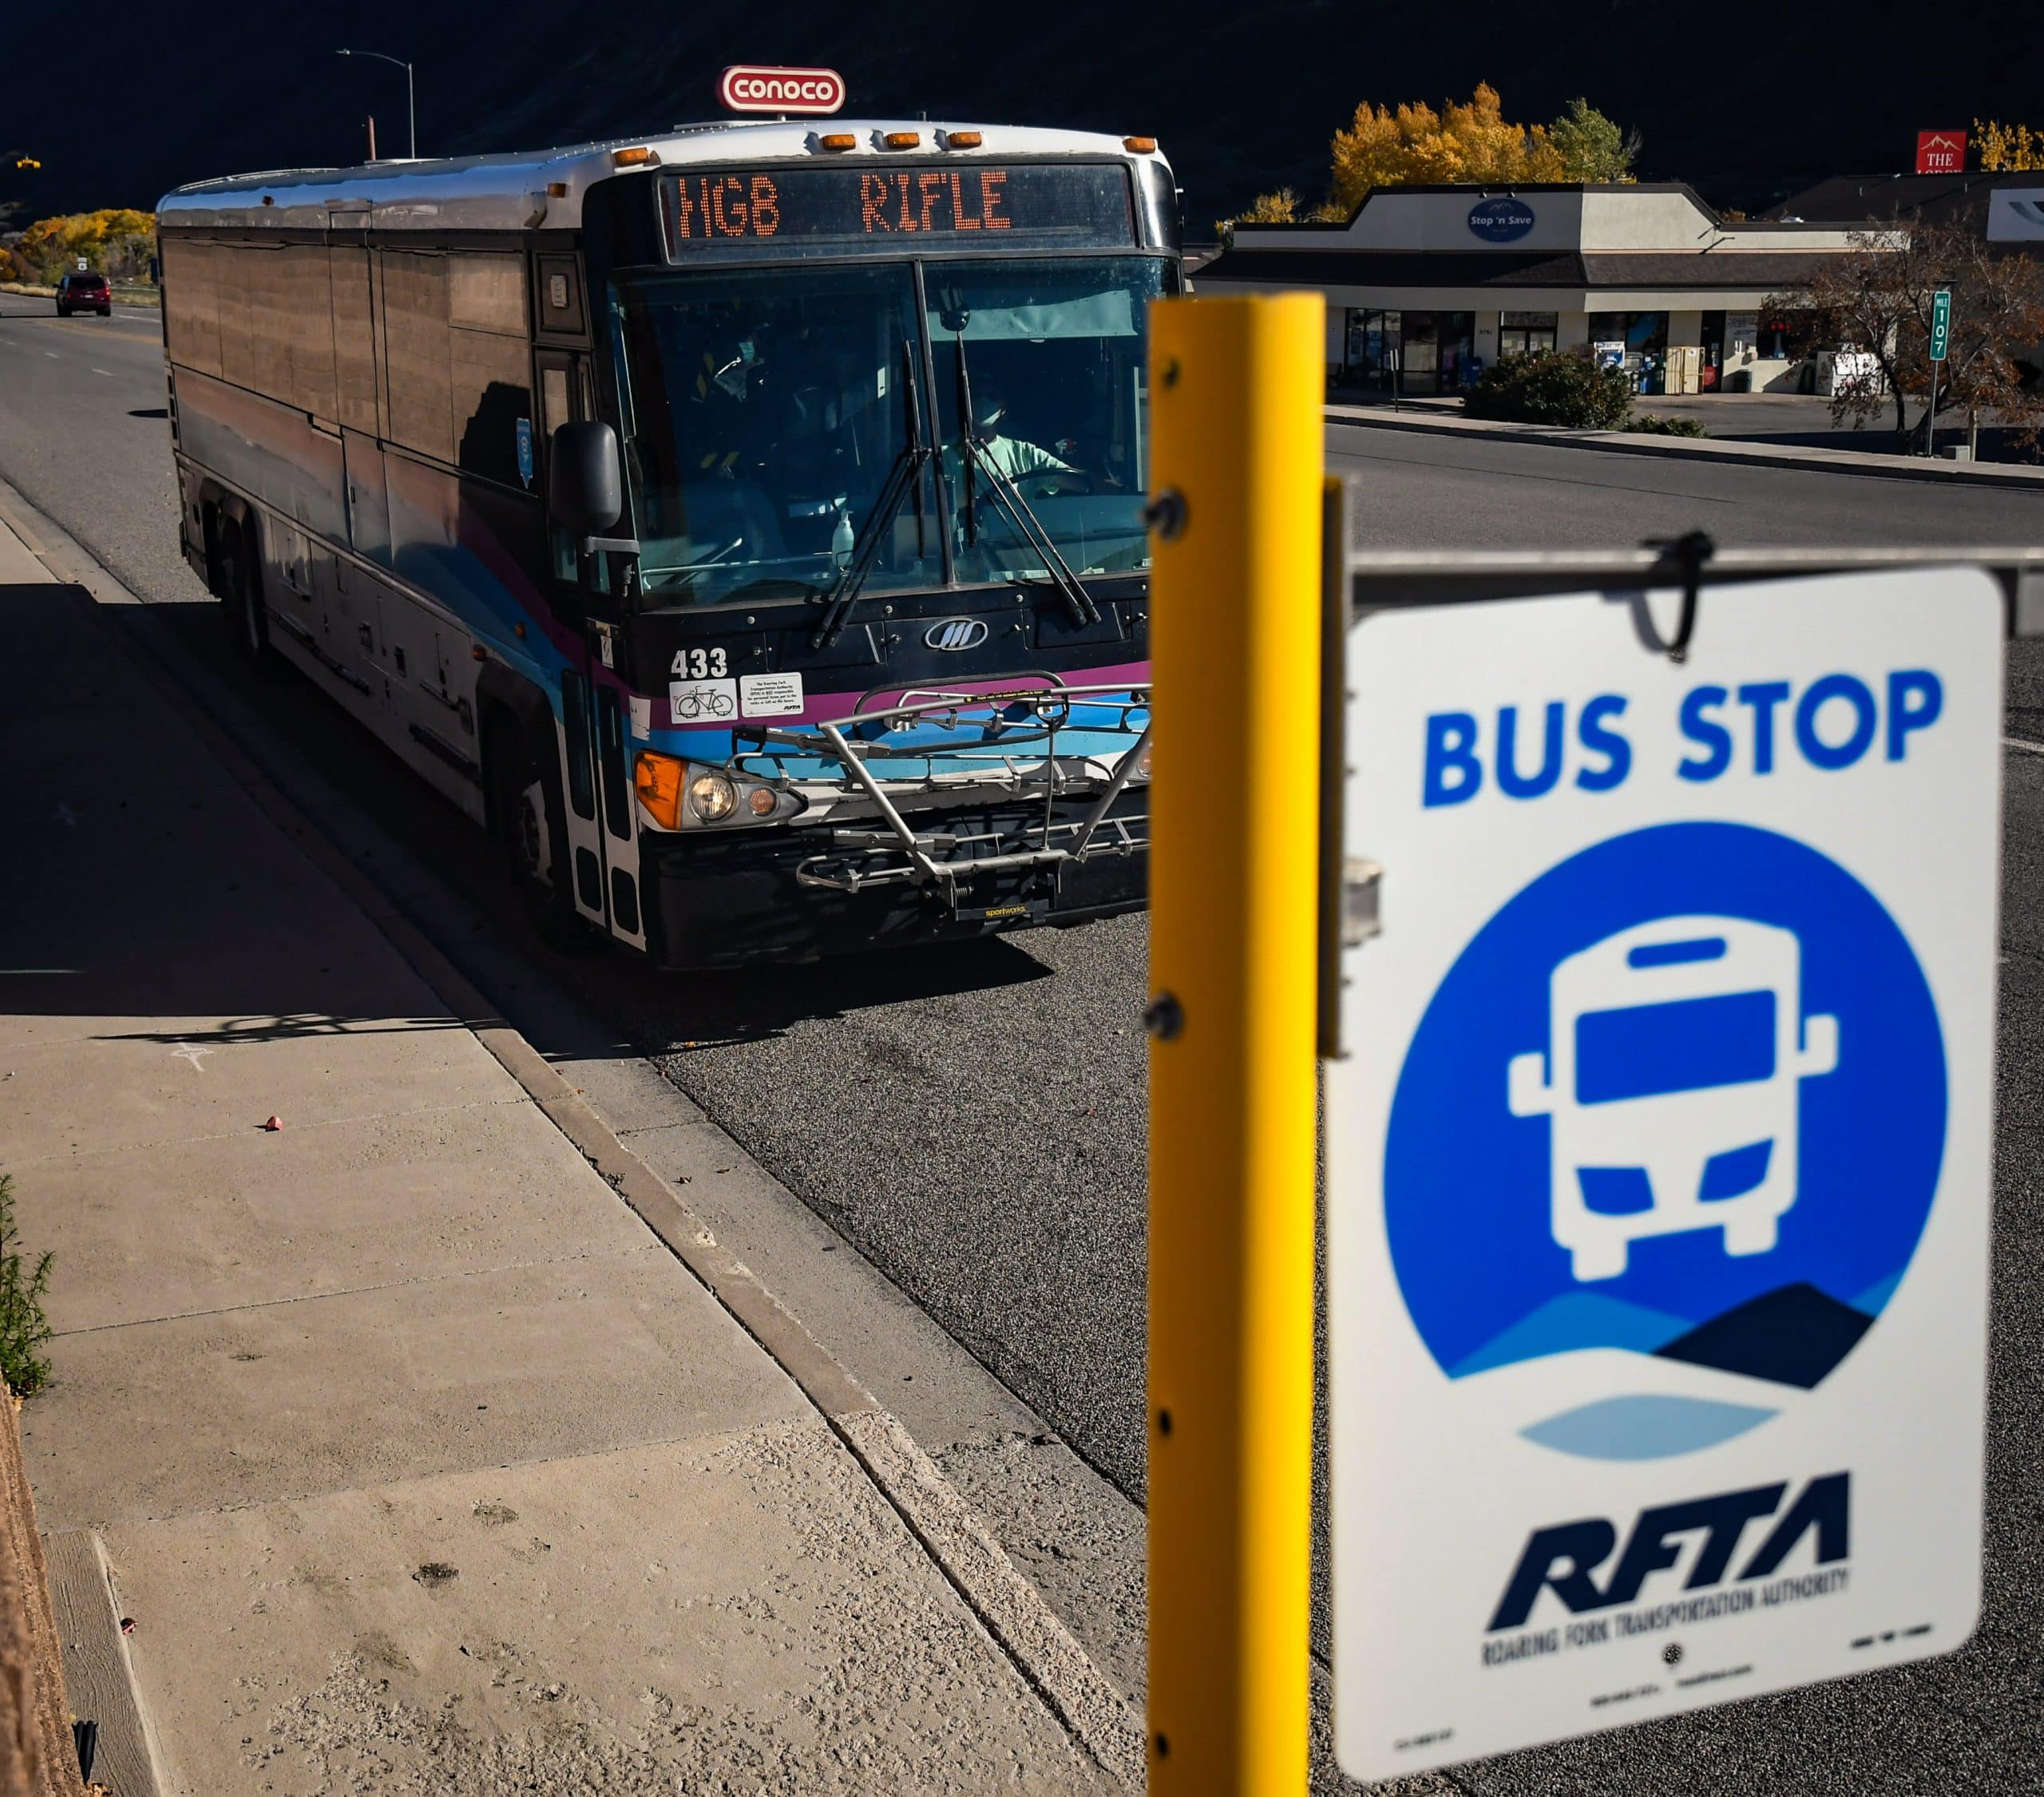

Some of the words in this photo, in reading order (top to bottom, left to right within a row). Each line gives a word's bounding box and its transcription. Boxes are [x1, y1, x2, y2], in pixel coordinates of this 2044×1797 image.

[734, 79, 834, 101] CONOCO
[1927, 153, 1953, 166] THE
[679, 176, 779, 238] HGB
[861, 172, 1011, 233] RIFLE
[1471, 216, 1493, 226] Stop
[1935, 310, 1945, 354] 107
[671, 647, 727, 679] 433
[1422, 695, 1632, 808] BUS
[1675, 670, 1943, 782] STOP
[985, 906, 1027, 917] sportworks
[1484, 1470, 1852, 1632] RFTA
[1482, 1629, 1559, 1668] ROARING
[1564, 1619, 1610, 1648] FORK
[1614, 1588, 1754, 1637] TRANSPORTATION
[1758, 1568, 1848, 1608] AUTHORITY
